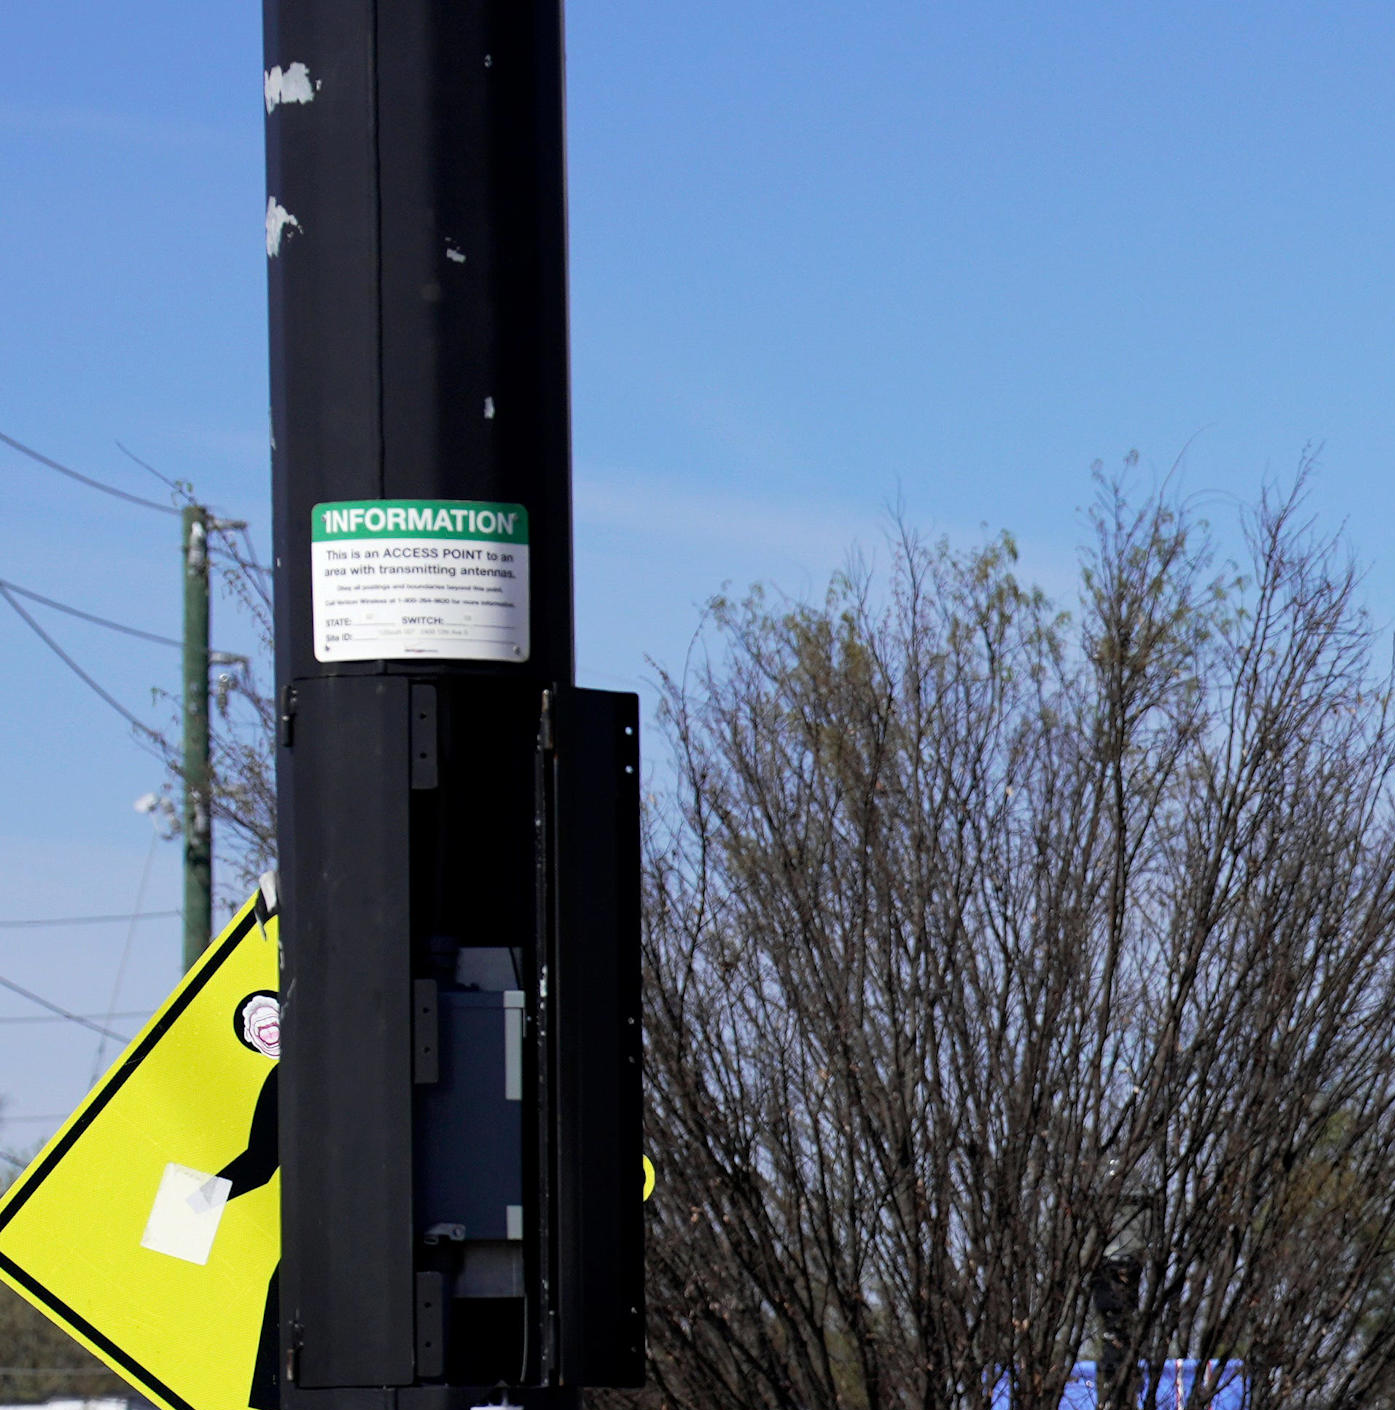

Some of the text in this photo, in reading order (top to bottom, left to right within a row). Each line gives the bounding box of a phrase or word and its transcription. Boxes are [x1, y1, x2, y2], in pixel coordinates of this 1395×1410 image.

[325, 507, 514, 535] INFORMATION
[326, 548, 514, 562] This is an ACCESS POINT to an
[325, 564, 516, 579] area with transmitting antennas.
[326, 616, 444, 628] STATE: SWITCH:
[326, 632, 352, 642] Site ID:
